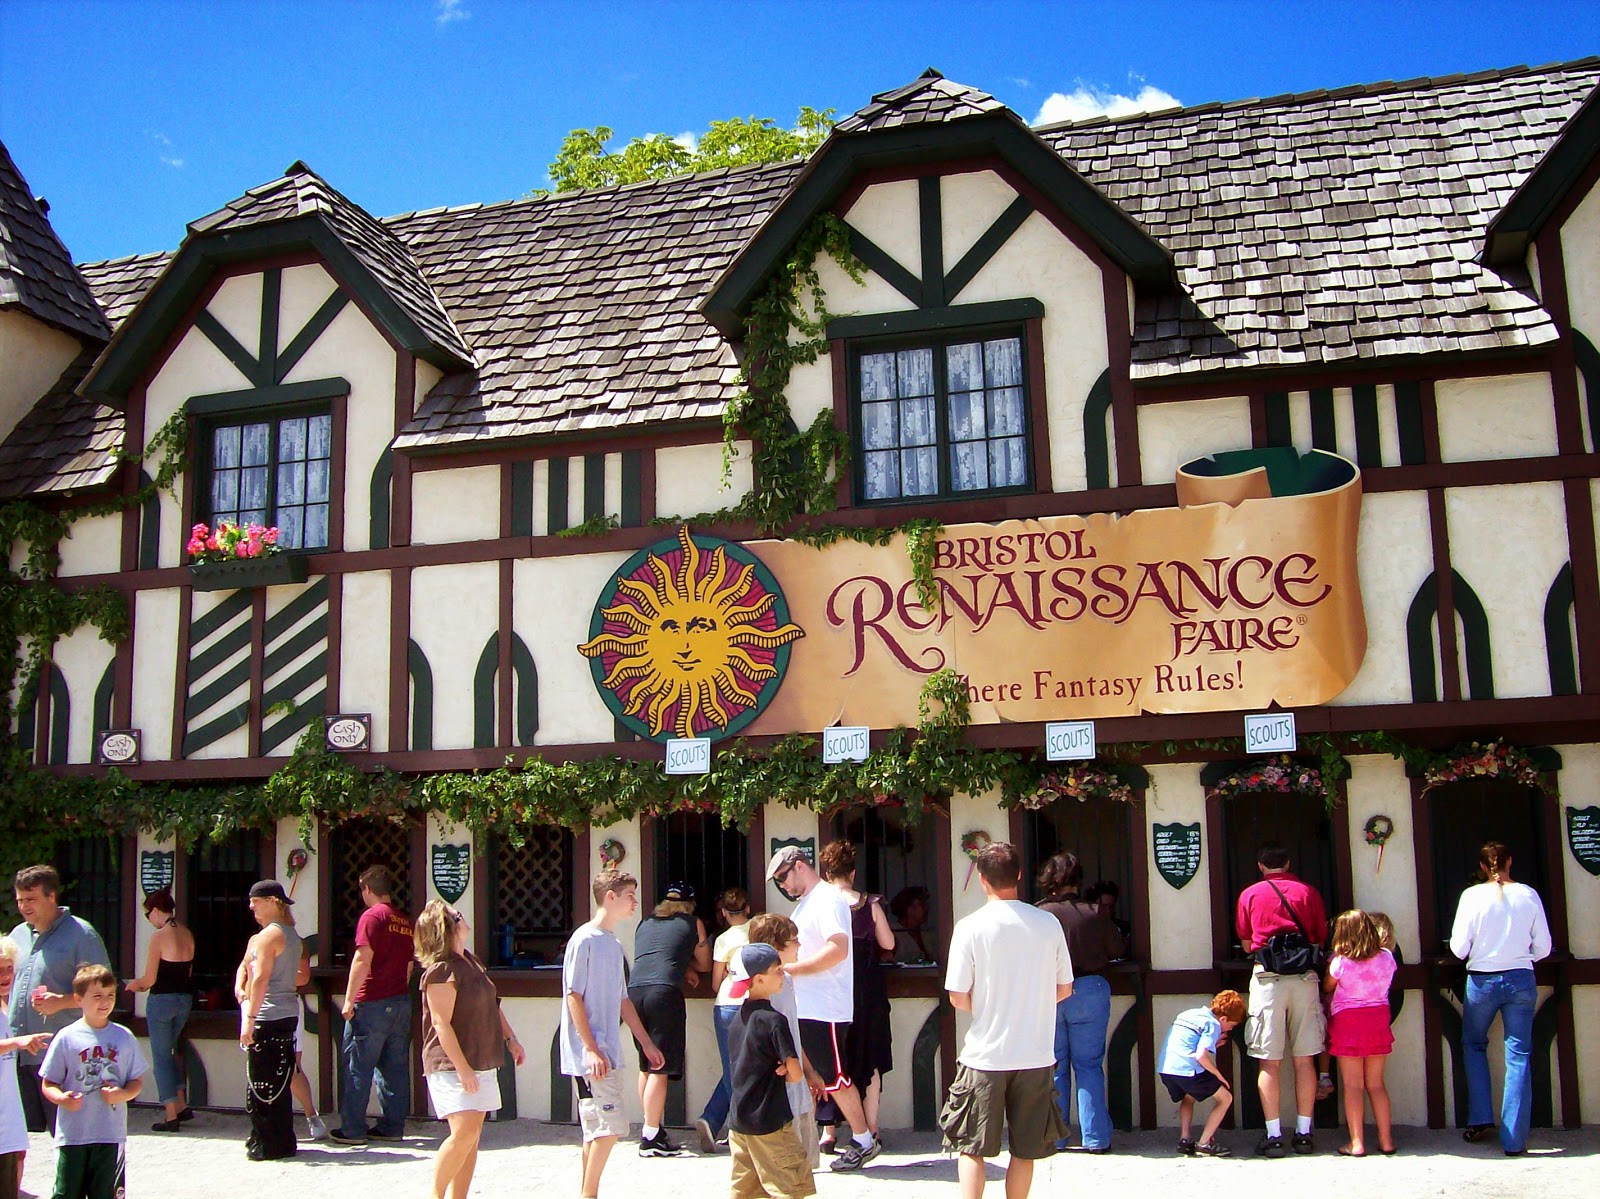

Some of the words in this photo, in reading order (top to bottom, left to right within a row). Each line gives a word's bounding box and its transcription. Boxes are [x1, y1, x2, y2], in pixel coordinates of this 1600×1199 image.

[932, 529, 1097, 572] BRISTOL
[827, 553, 1332, 677] RENAISSANCE
[1171, 616, 1300, 661] FAIRE
[955, 673, 1022, 703] here
[1033, 670, 1143, 706] Fantasy
[1154, 660, 1243, 693] Rules!
[333, 735, 357, 744] ONLY
[828, 732, 865, 757] SCOUTS
[1051, 728, 1090, 753] SCOUTS
[1250, 719, 1290, 746] SCOUTS
[107, 749, 128, 757] ONLY
[670, 743, 706, 768] SCOUTS
[79, 1045, 118, 1063] TAZ
